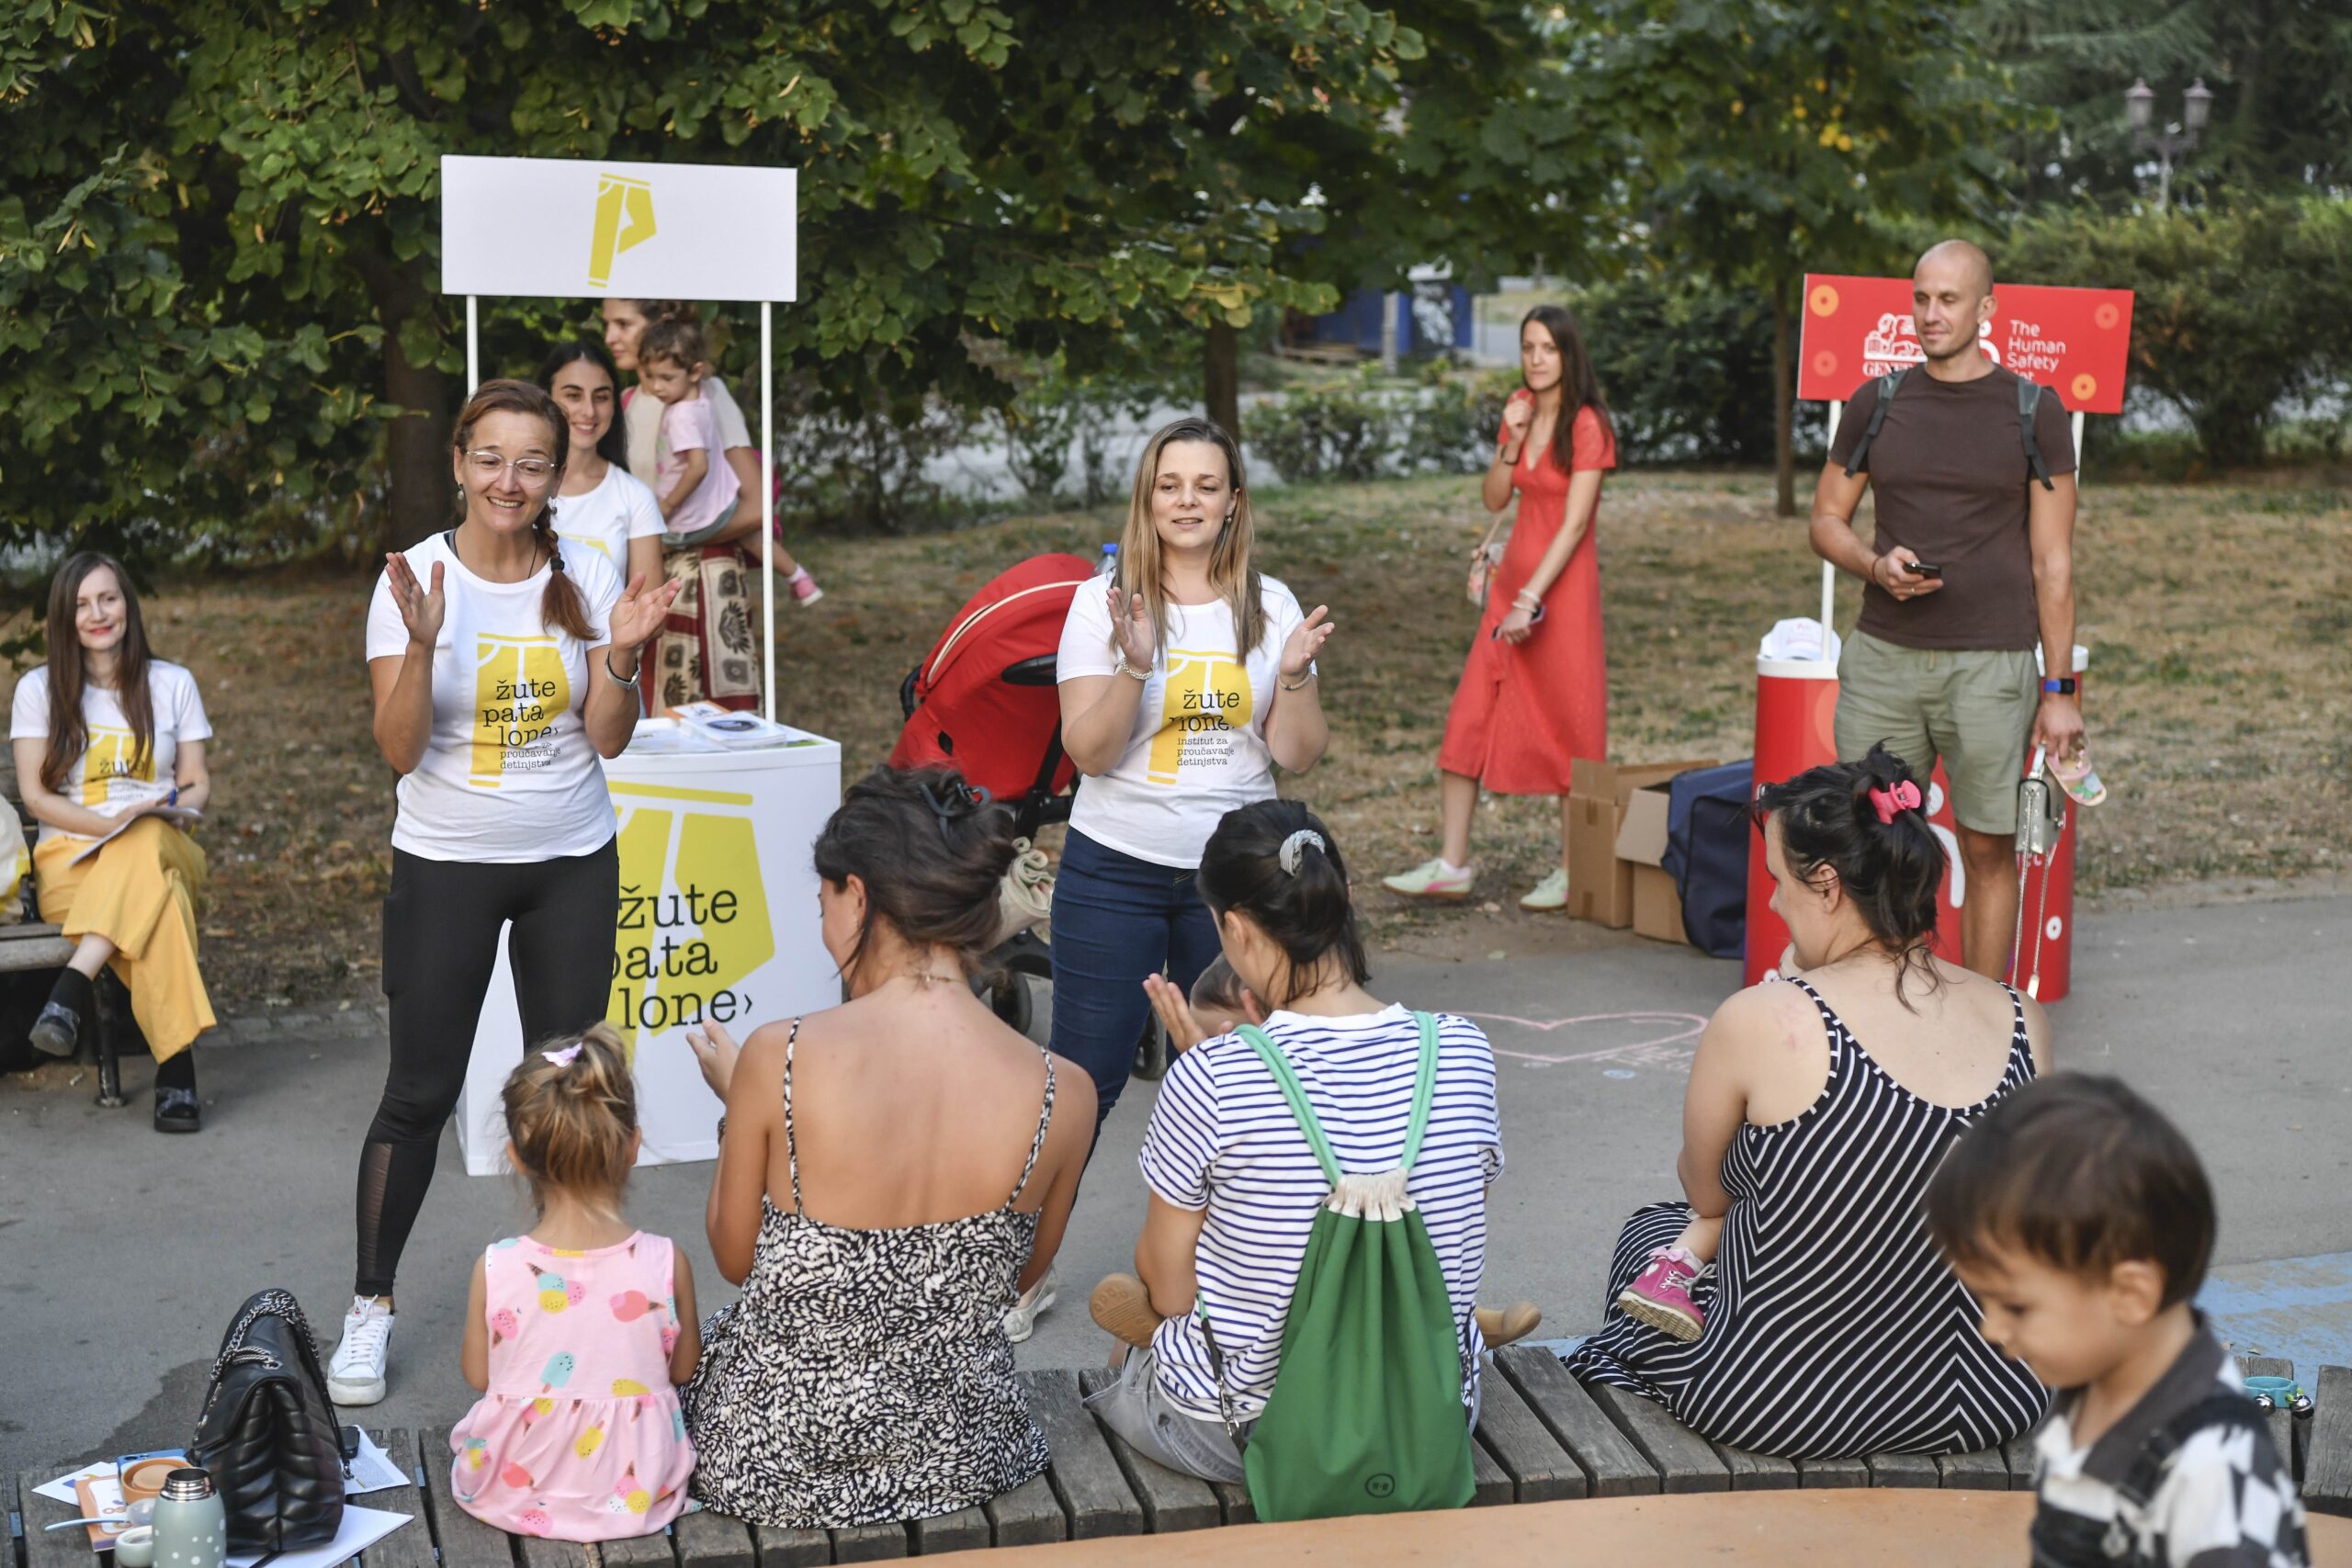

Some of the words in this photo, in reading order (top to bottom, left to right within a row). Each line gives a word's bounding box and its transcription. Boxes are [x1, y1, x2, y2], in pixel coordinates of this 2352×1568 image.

[2009, 319, 2041, 337] The
[2007, 336, 2066, 355] Human
[2007, 351, 2060, 373] Safety
[496, 678, 556, 700] žute
[1182, 688, 1240, 709] žute
[482, 702, 544, 728] pata
[1177, 737, 1215, 745] institut
[1176, 747, 1235, 757] proučavanje
[1176, 758, 1228, 767] detinjstva
[616, 883, 738, 931] žute
[612, 935, 718, 981] ata
